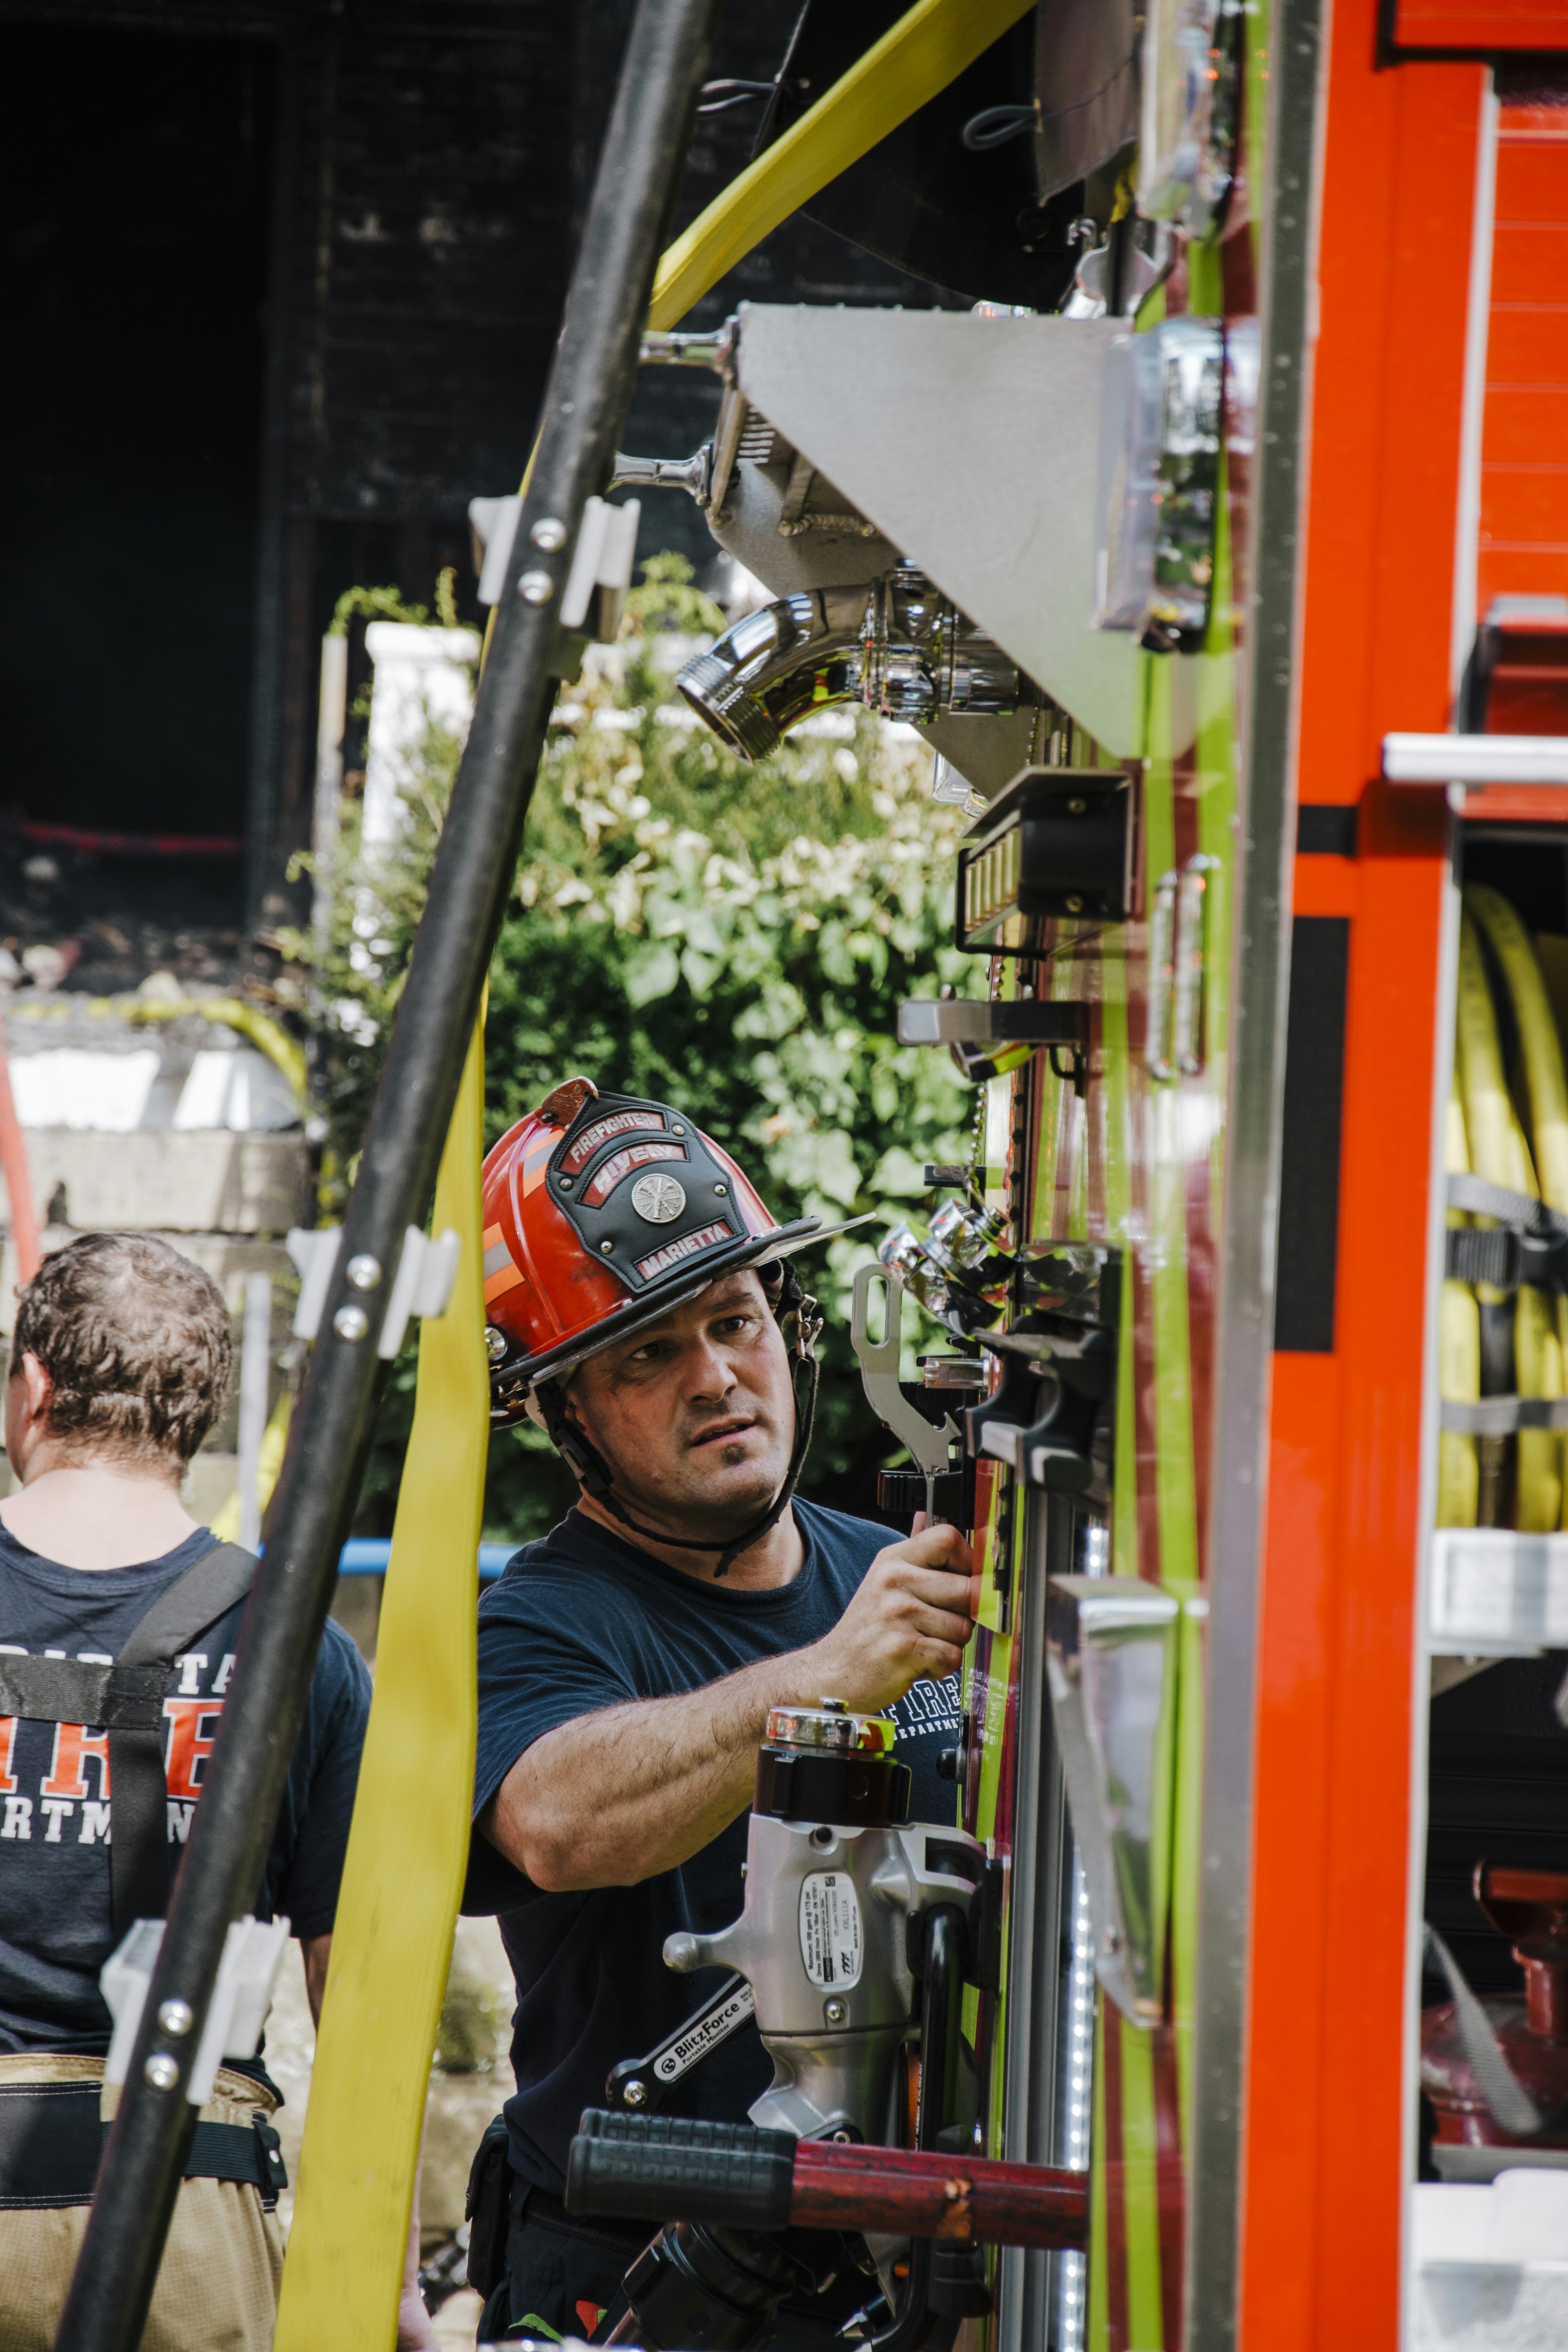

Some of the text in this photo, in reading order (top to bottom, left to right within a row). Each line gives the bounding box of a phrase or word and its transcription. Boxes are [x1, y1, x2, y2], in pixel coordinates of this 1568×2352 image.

[570, 1112, 655, 1164] FIREFIGHTER
[593, 1143, 674, 1194] HIVELY
[641, 1224, 729, 1277] MARIETTA
[894, 1718, 959, 1740] EPARTME
[674, 2003, 740, 2059] BlitzForce
[682, 2043, 706, 2065] Portable
[706, 2023, 730, 2044] Monitor
